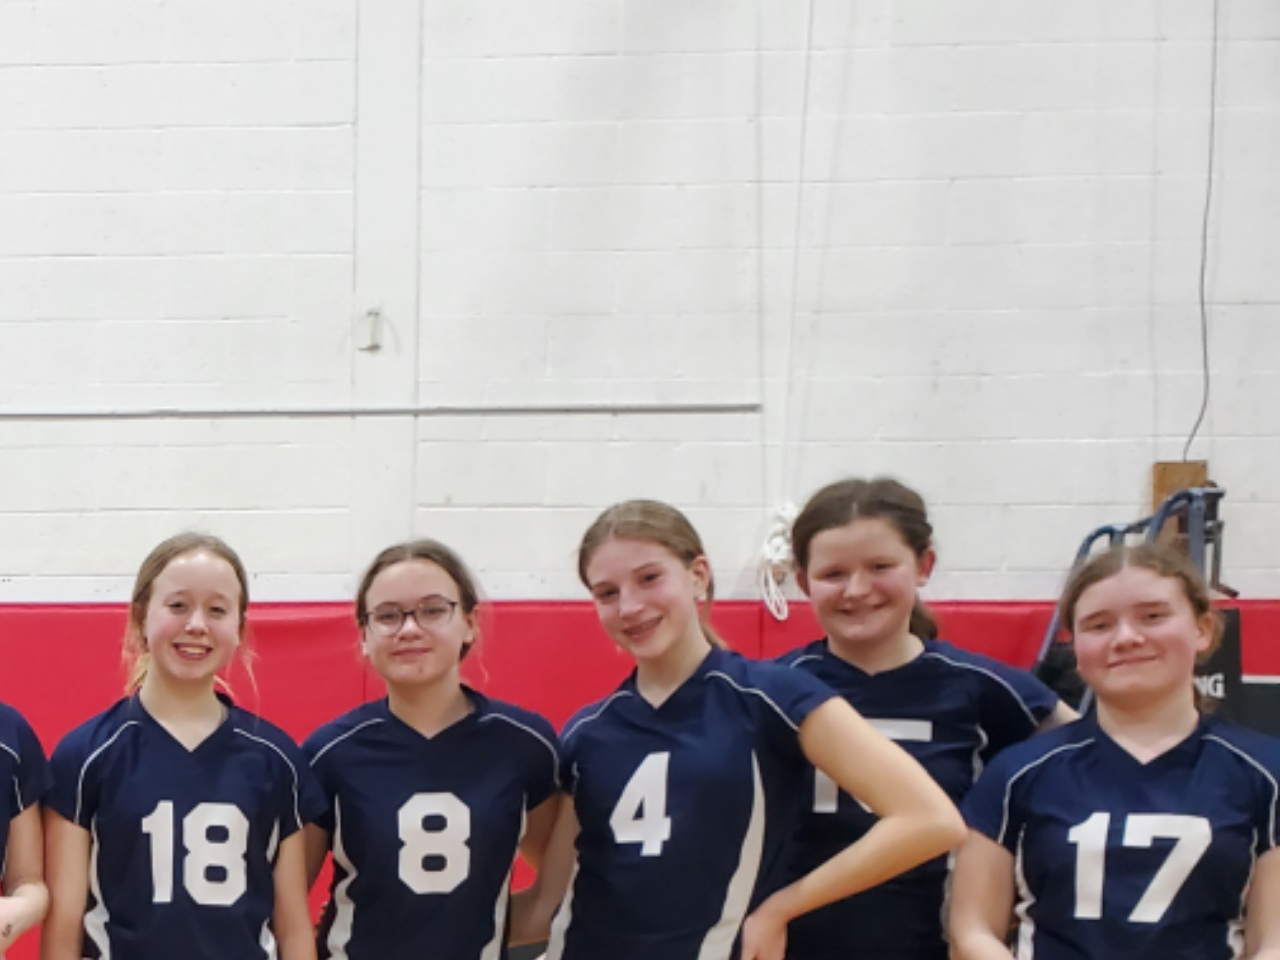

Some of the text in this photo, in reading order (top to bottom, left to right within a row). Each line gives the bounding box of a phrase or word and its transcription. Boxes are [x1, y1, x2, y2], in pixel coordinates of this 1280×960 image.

[141, 800, 250, 906] 18
[397, 791, 471, 894] 8
[609, 751, 671, 857] 4
[1067, 812, 1212, 923] 17
